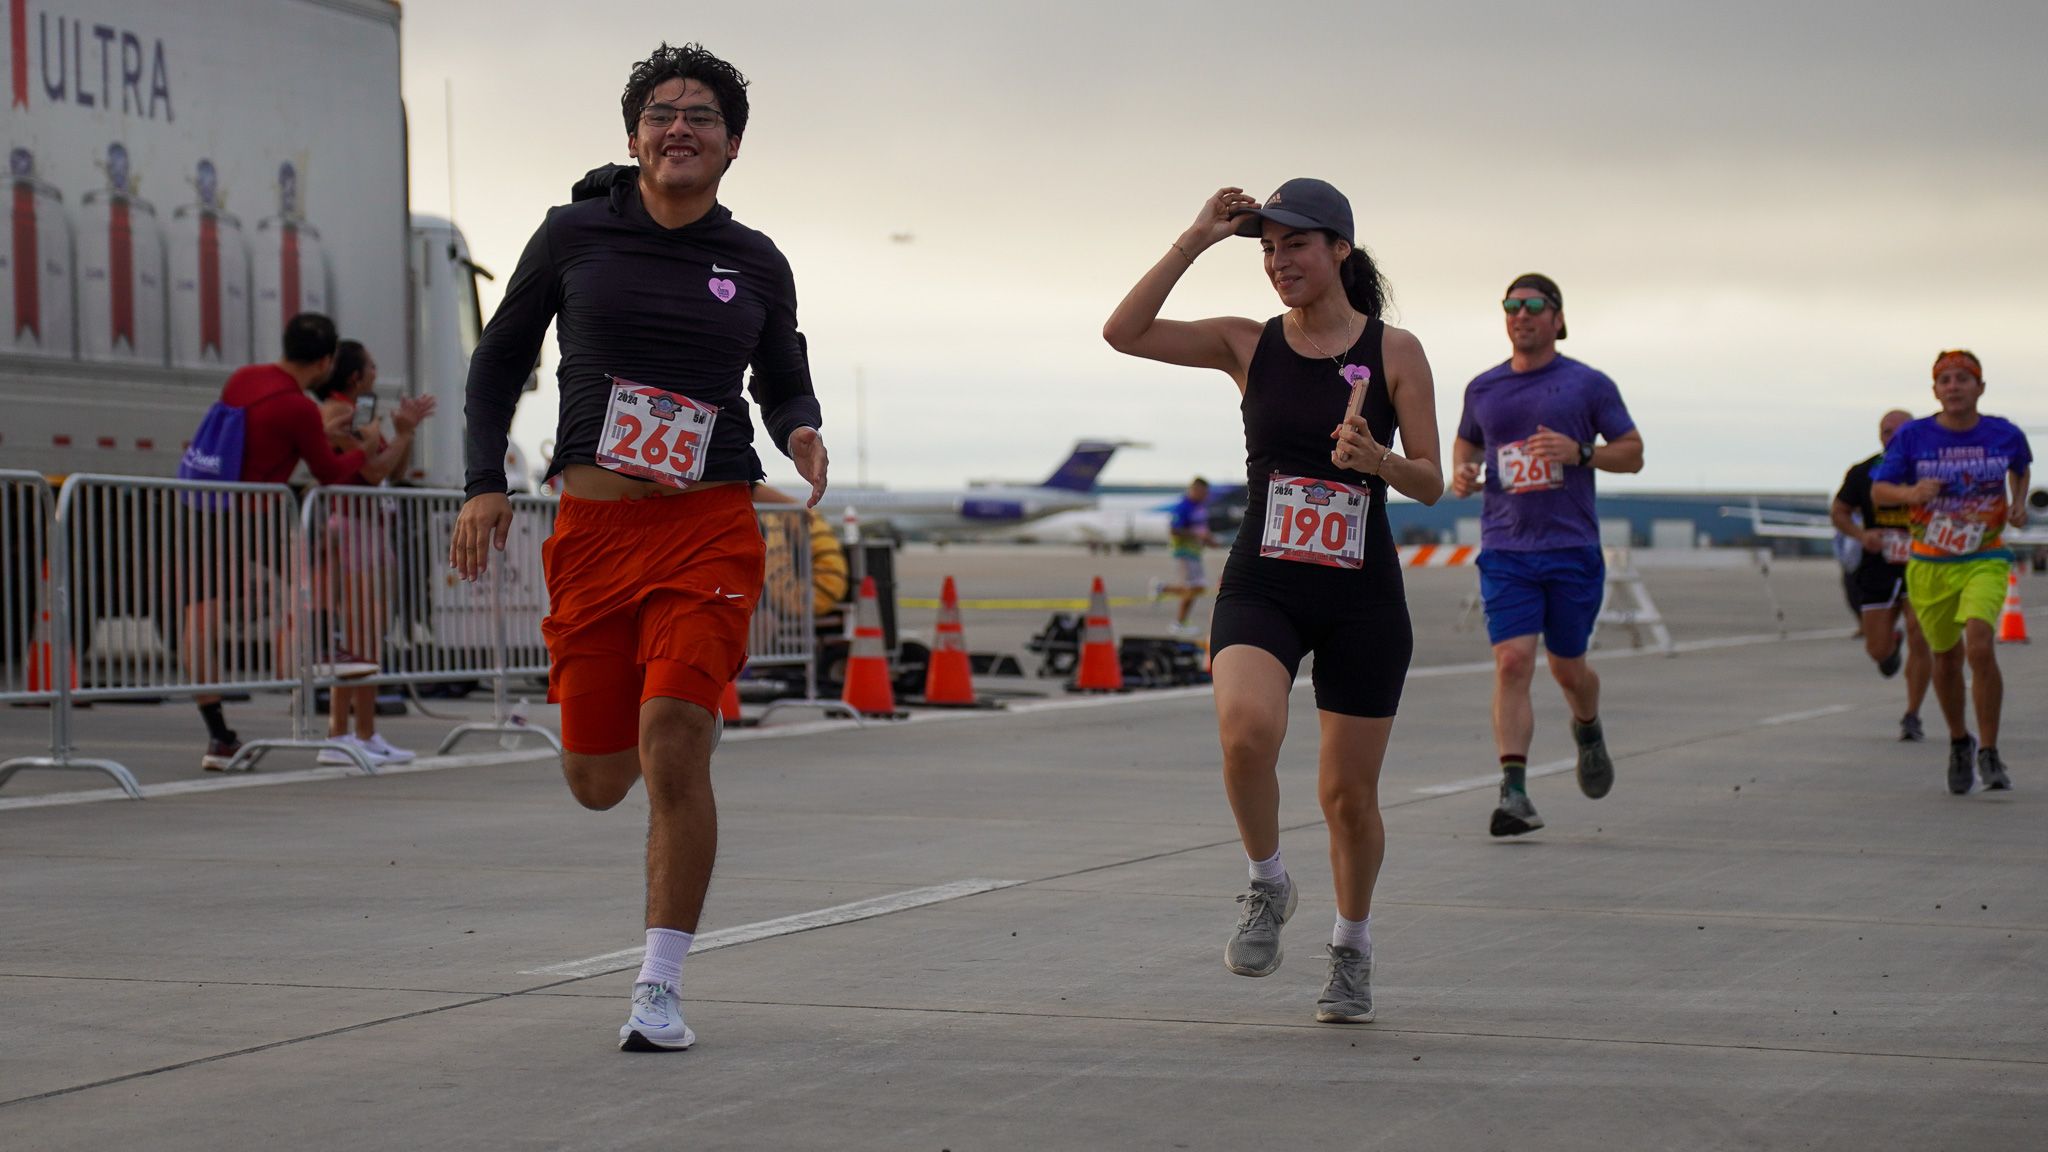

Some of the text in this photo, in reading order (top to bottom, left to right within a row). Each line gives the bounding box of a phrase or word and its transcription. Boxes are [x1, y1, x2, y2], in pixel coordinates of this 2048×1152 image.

[40, 11, 174, 123] ULTRA
[617, 391, 639, 406] 2024
[610, 414, 698, 473] 265
[1509, 457, 1552, 484] 261
[1274, 486, 1293, 497] 2024
[1280, 504, 1348, 551] 190
[1938, 526, 1968, 552] 114
